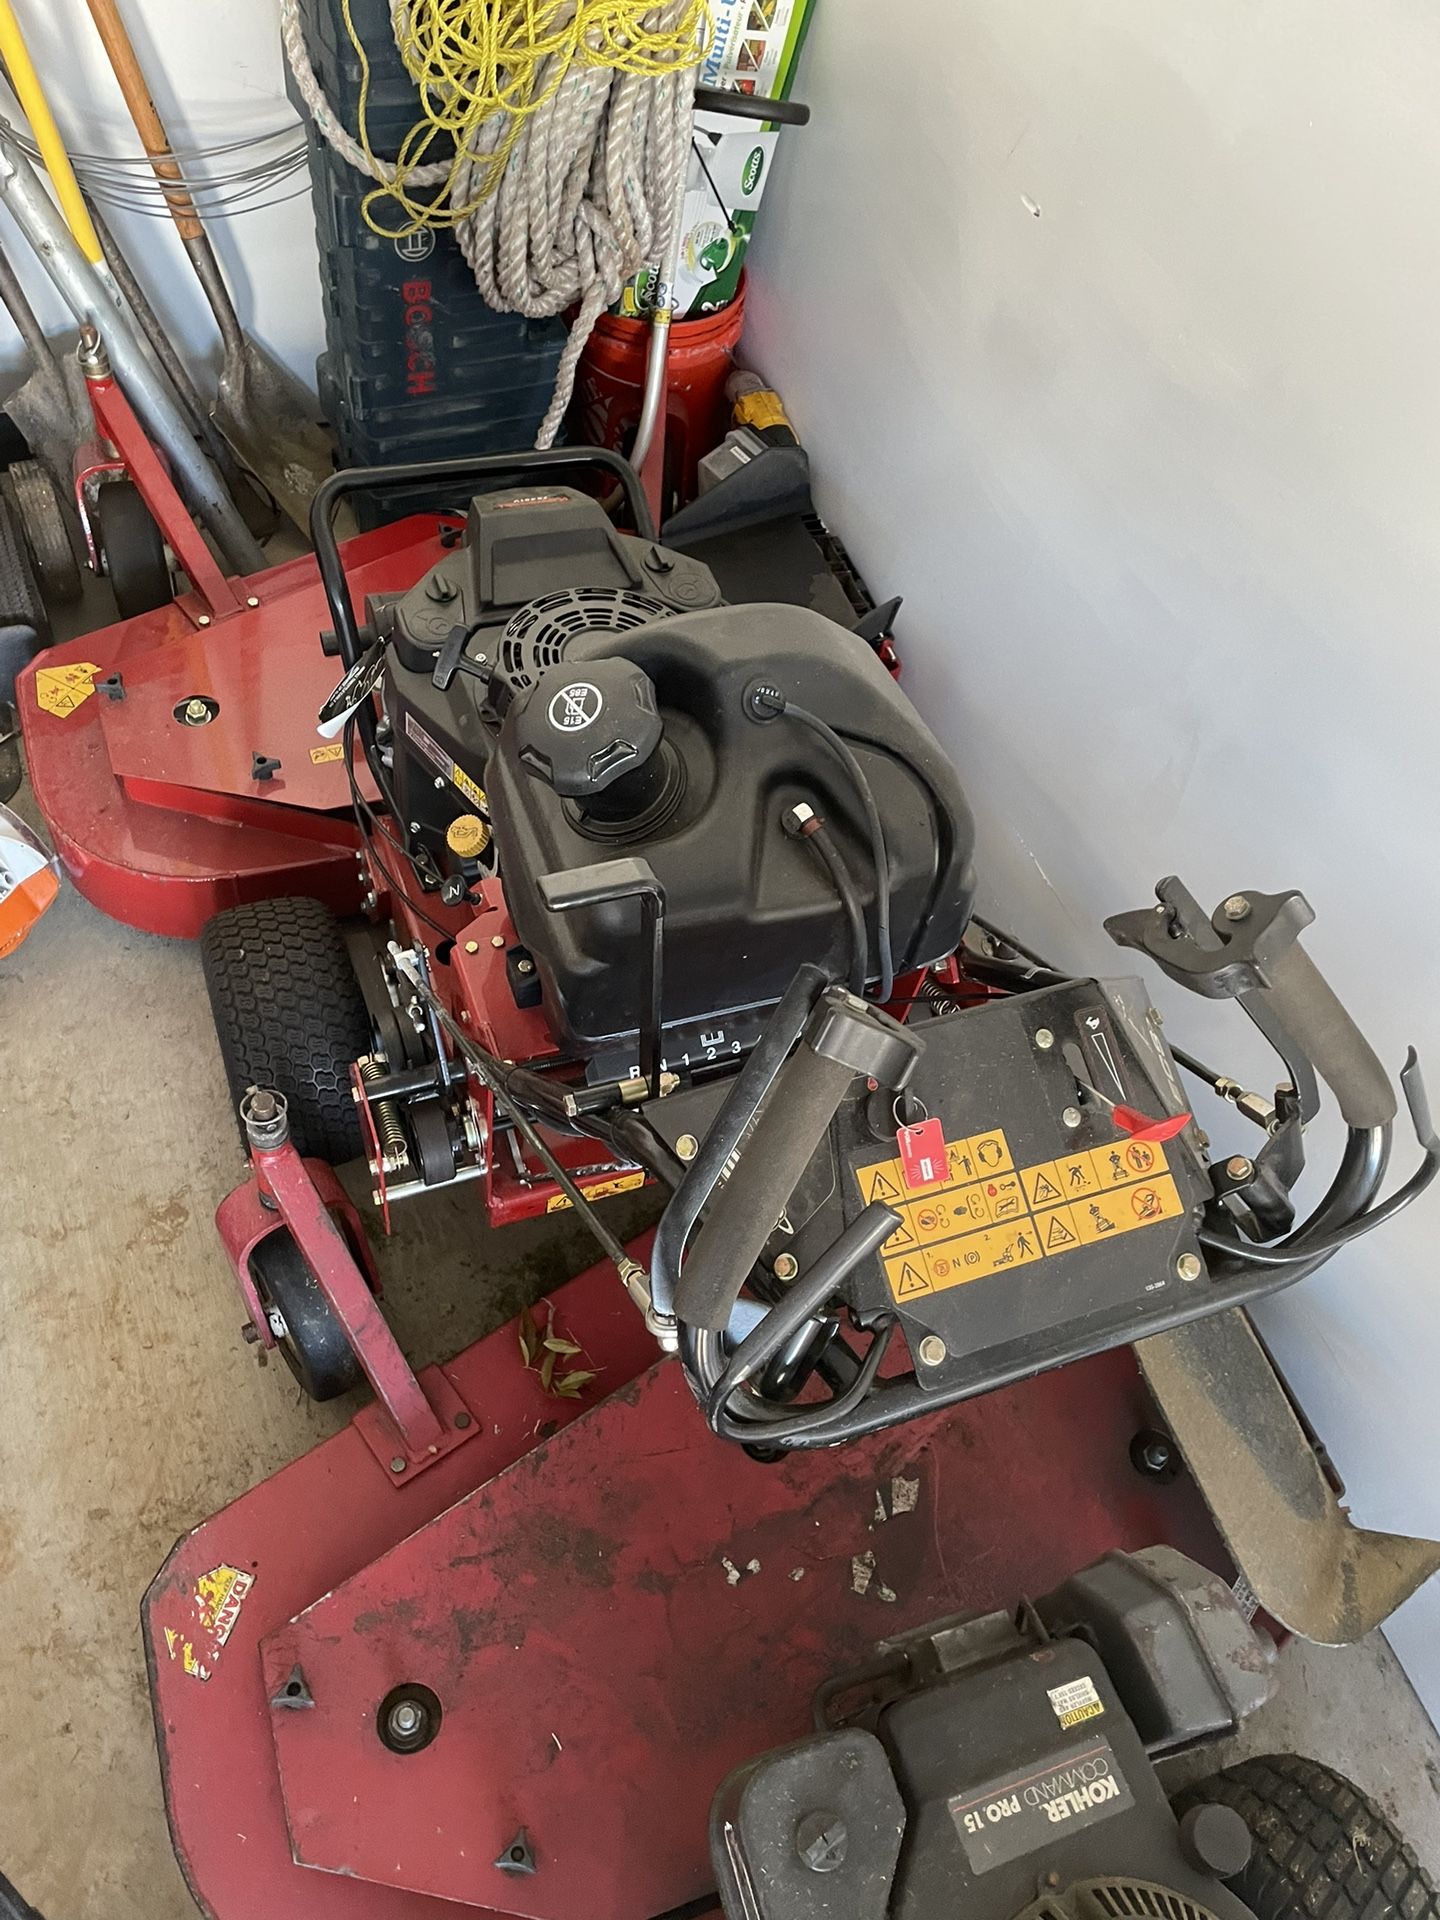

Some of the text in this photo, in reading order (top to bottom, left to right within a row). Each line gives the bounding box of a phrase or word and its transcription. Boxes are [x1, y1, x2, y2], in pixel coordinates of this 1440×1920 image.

[744, 151, 762, 190] Scotts
[641, 263, 661, 301] Scot
[402, 279, 438, 394] BOSCH
[569, 688, 588, 698] E85
[563, 715, 582, 726] E15
[681, 1052, 690, 1066] 1
[706, 1047, 717, 1060] 2
[731, 1041, 741, 1054] 3
[214, 1580, 248, 1640] DANG
[1023, 1757, 1109, 1806] COMMAND
[1045, 1775, 1121, 1823] KOHLER
[963, 1811, 985, 1834] 15
